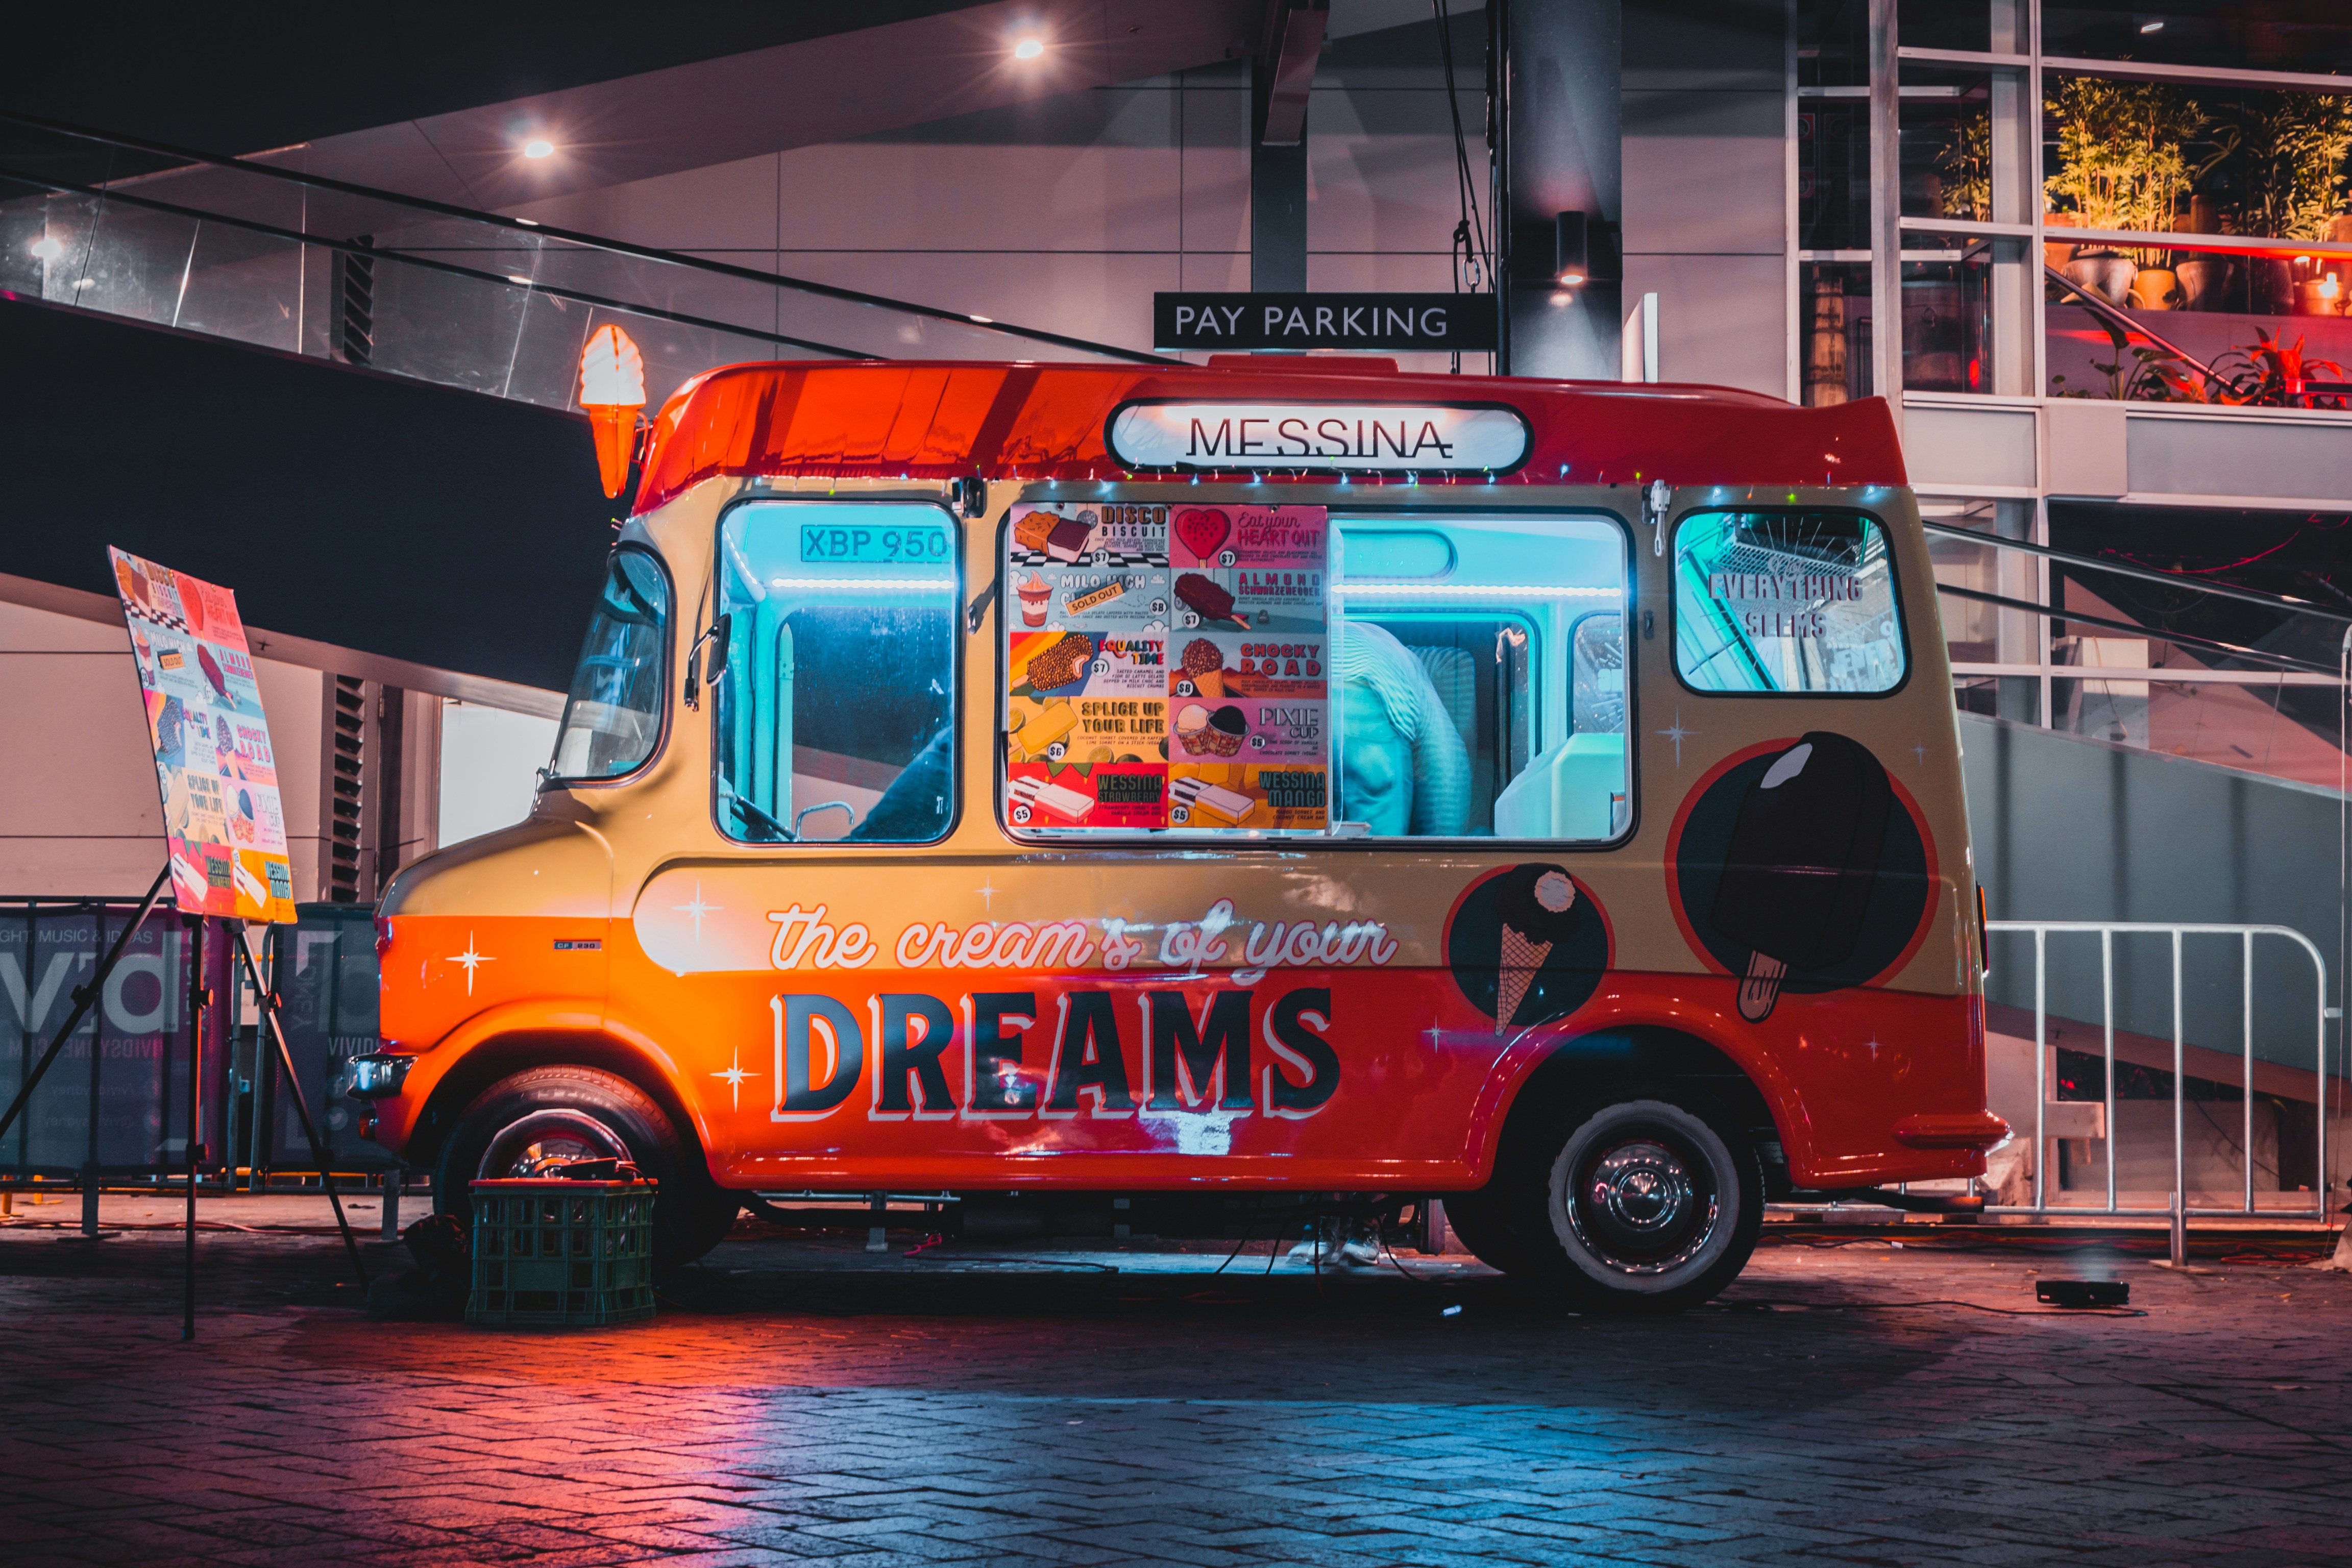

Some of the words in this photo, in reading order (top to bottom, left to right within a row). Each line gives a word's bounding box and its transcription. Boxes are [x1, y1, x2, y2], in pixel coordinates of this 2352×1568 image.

[1177, 307, 1244, 335] PAY
[1265, 307, 1447, 337] PARKING
[1186, 418, 1453, 458] MESSINA
[1101, 506, 1166, 524] DISCO
[1102, 526, 1166, 537] BISCUIT
[1237, 528, 1289, 547] HEART
[1291, 529, 1320, 547] OUT
[806, 529, 871, 556] XBP
[883, 530, 948, 557] 950
[1095, 552, 1106, 562] $7
[1221, 554, 1233, 564] $7
[1060, 574, 1101, 589] MILO
[1239, 572, 1320, 586] ALMOND
[1239, 585, 1320, 596] SCHWARZENEGGER
[1708, 574, 1863, 601] EVERYTHING
[1072, 595, 1097, 611] SOLD
[1098, 585, 1117, 599] OUT
[1152, 602, 1164, 612] $8
[1186, 615, 1196, 625] $7
[1746, 612, 1827, 638] SEEMS
[1099, 639, 1164, 658] EQUALITY
[1240, 643, 1319, 658] CHOCKY
[1132, 652, 1164, 665] TIME
[1094, 664, 1105, 673] $7
[1240, 658, 1321, 676] ROAD
[1179, 683, 1191, 693] $8
[1143, 702, 1164, 717] UP
[1259, 708, 1318, 726] PIXIE
[1083, 719, 1125, 733] YOUR
[1130, 719, 1164, 733] LIFE
[1289, 727, 1319, 739] CUP
[1252, 738, 1263, 748] $5
[1050, 746, 1062, 756] $6
[1097, 774, 1163, 791] WESSINA
[1259, 771, 1325, 789] WESSINA
[1098, 791, 1161, 803] STRAWBERRY
[1268, 790, 1326, 807] MANGO
[1016, 810, 1028, 820] $5
[1173, 810, 1186, 820] $5
[39, 929, 88, 943] MUSIC
[106, 930, 154, 944] IDAS
[767, 903, 877, 970] the
[1159, 897, 1229, 974] of
[1230, 919, 1400, 986] your
[328, 1037, 380, 1061] VIVID
[770, 987, 1341, 1122] DREAMS
